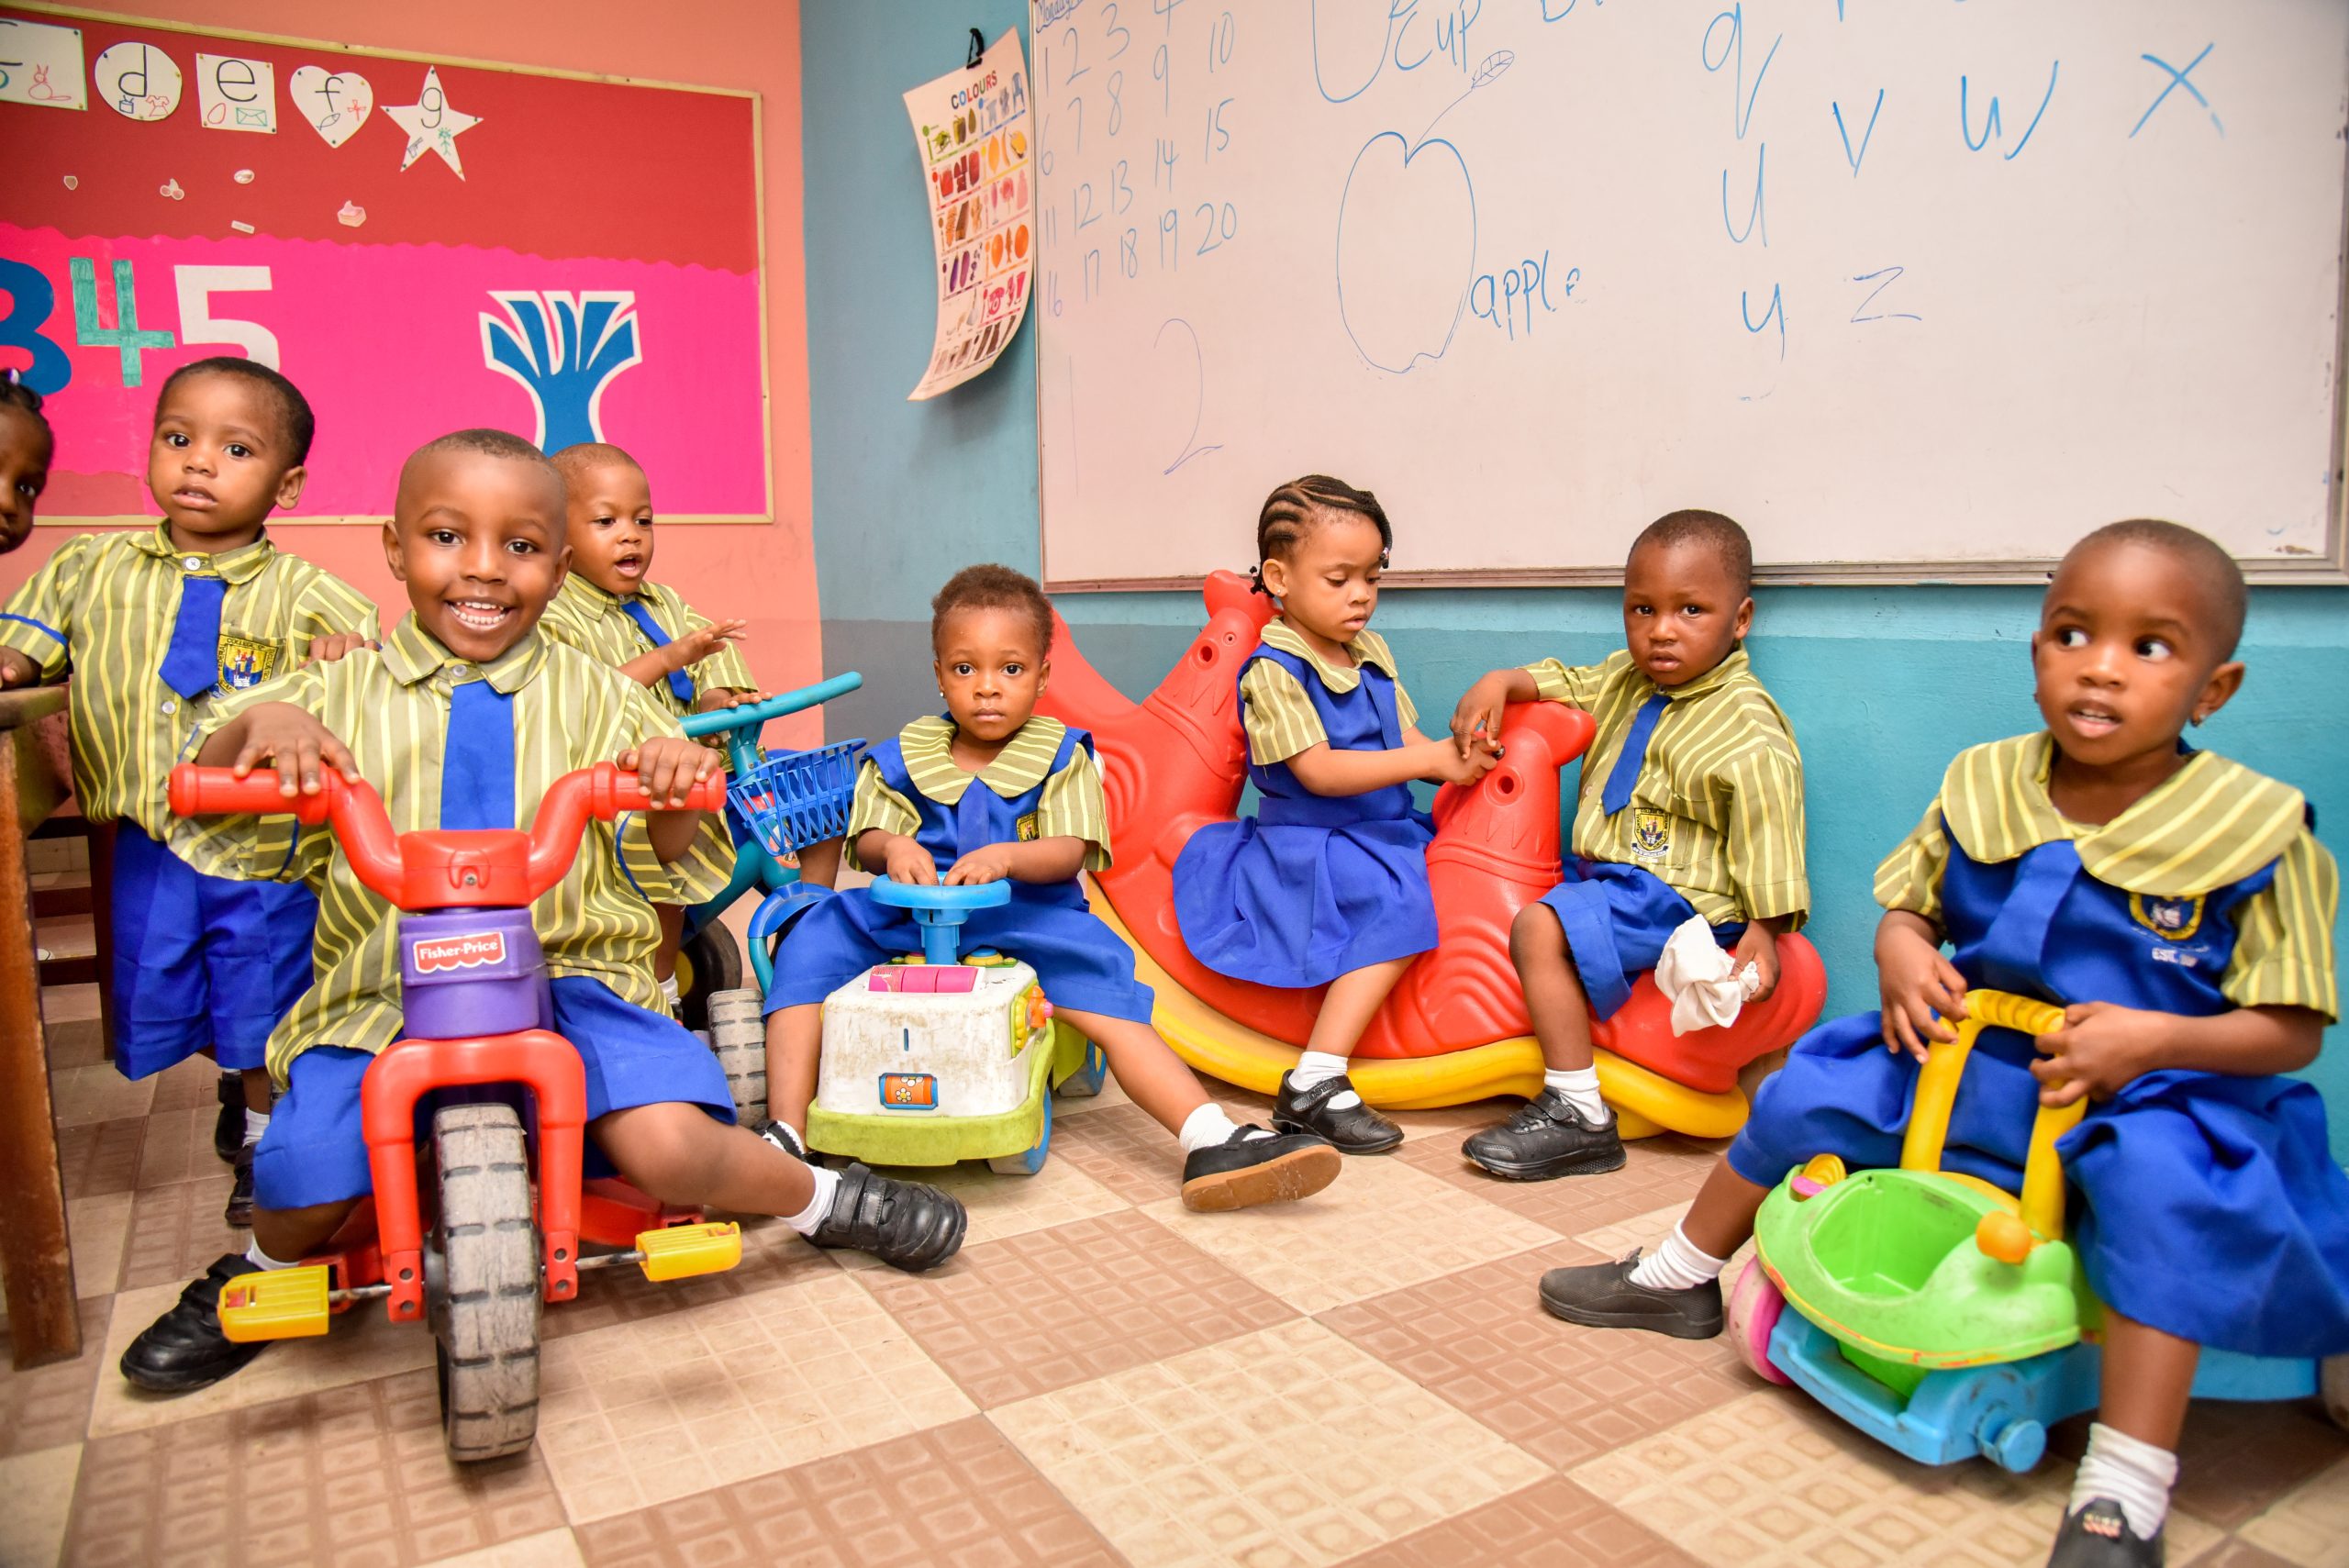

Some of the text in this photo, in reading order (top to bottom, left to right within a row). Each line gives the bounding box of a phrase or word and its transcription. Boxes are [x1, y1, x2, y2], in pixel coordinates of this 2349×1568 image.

[117, 44, 444, 129] d e f g
[952, 70, 997, 110] COLOURS
[1041, 11, 1235, 175] 6 7 8 9 10
[1063, 27, 1092, 86] 2
[1101, 2, 1130, 61] 3
[1045, 97, 1235, 250] 11 12 13 14 15
[1047, 201, 1238, 317] 16 17 18 19 20
[69, 257, 176, 387] 4
[173, 264, 281, 374] 5
[419, 940, 499, 961] Fisher-Price
